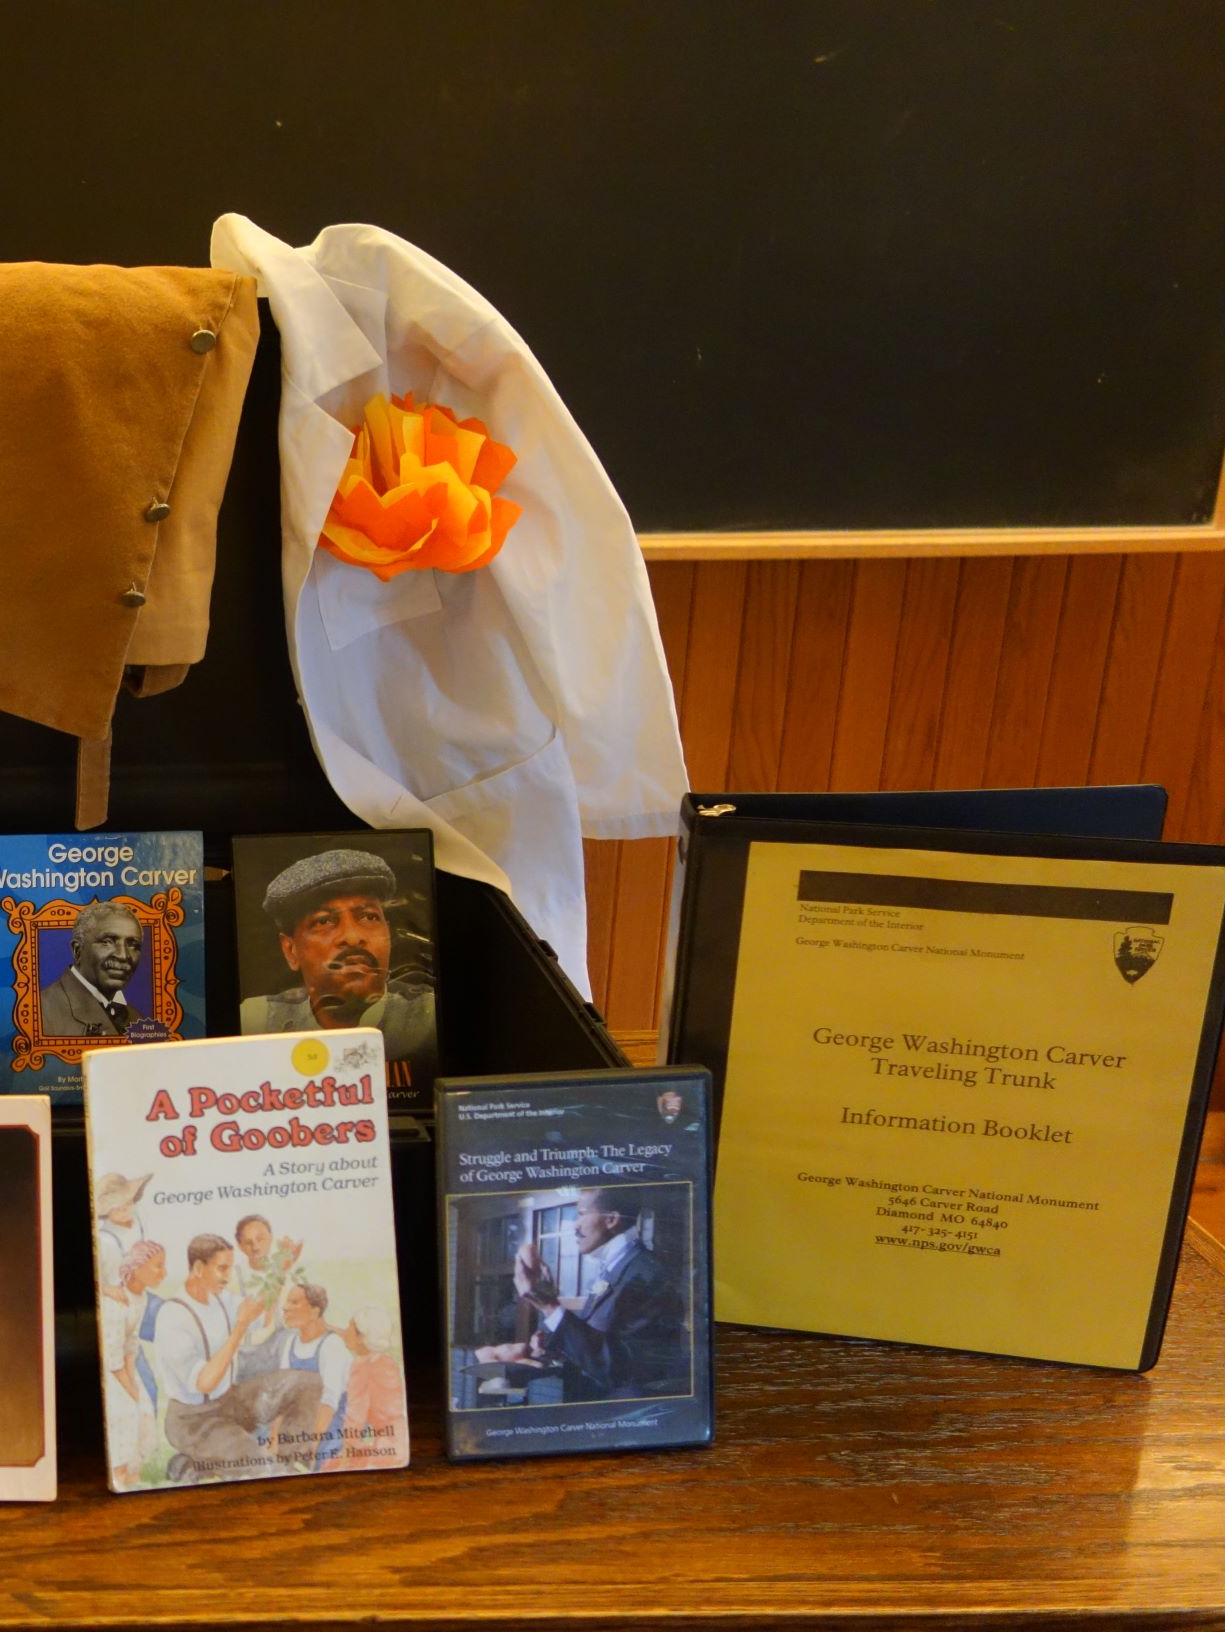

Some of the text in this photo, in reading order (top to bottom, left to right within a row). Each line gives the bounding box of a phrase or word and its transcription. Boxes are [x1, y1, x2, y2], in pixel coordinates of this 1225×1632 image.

[48, 843, 134, 867] George
[120, 867, 197, 886] Carver
[800, 903, 901, 918] National Park Service
[798, 914, 924, 931] Department of the Interior
[796, 936, 1025, 960] George Washington Carver National Monument
[813, 1027, 1127, 1069] George Washington Carver
[871, 1057, 1057, 1089] Traveling Trunk
[145, 1090, 179, 1122] A
[187, 1074, 374, 1118] Pocketful
[387, 1091, 420, 1099] arver
[458, 1101, 530, 1111] National Park Service
[473, 1111, 516, 1120] Department
[539, 1108, 564, 1116] Interior
[840, 1107, 1073, 1144] Information Booklet
[159, 1117, 376, 1158] of Goobers
[263, 1156, 378, 1177] A Story about
[459, 1143, 672, 1167] Struggle and Triumph: The Legacy
[459, 1162, 646, 1184] of George Washington Carver
[153, 1176, 379, 1206] George Washington Carver
[797, 1171, 1099, 1210] George Washington Carver National Monument
[887, 1195, 999, 1214] 5646 Carver Road
[876, 1206, 1008, 1231] Diamond MO 64840
[875, 1235, 1001, 1256] www.nps.gov/gwca
[257, 1425, 395, 1449] by Barbara Mitchell
[486, 1419, 658, 1437] George Washington Carver National Monument
[277, 1453, 292, 1465] by
[294, 1450, 328, 1464] Peter
[346, 1446, 397, 1459] Hanson
